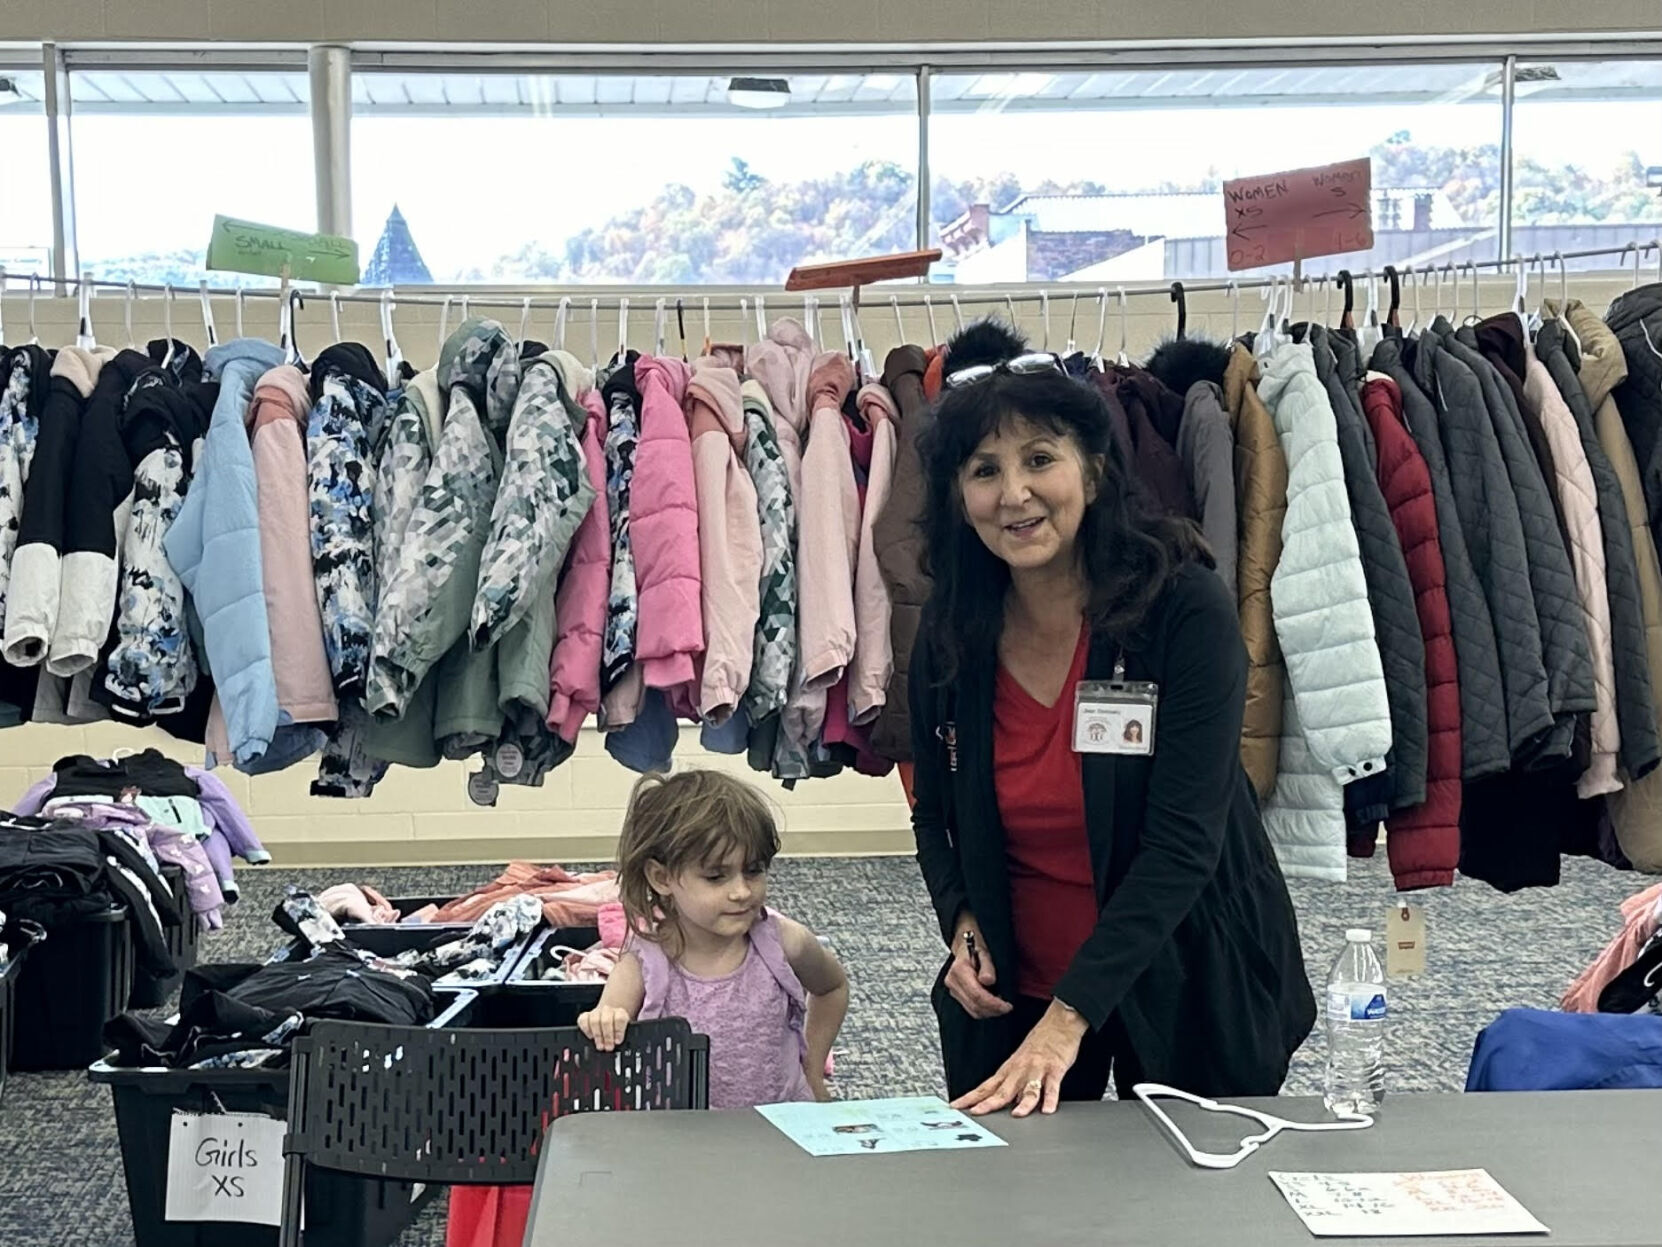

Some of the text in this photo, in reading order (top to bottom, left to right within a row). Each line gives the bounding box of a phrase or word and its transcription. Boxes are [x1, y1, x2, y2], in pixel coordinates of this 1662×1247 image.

[1234, 204, 1264, 219] XS
[234, 236, 289, 251] SMALL
[195, 1136, 258, 1168] Girls
[211, 1175, 245, 1198] XS
